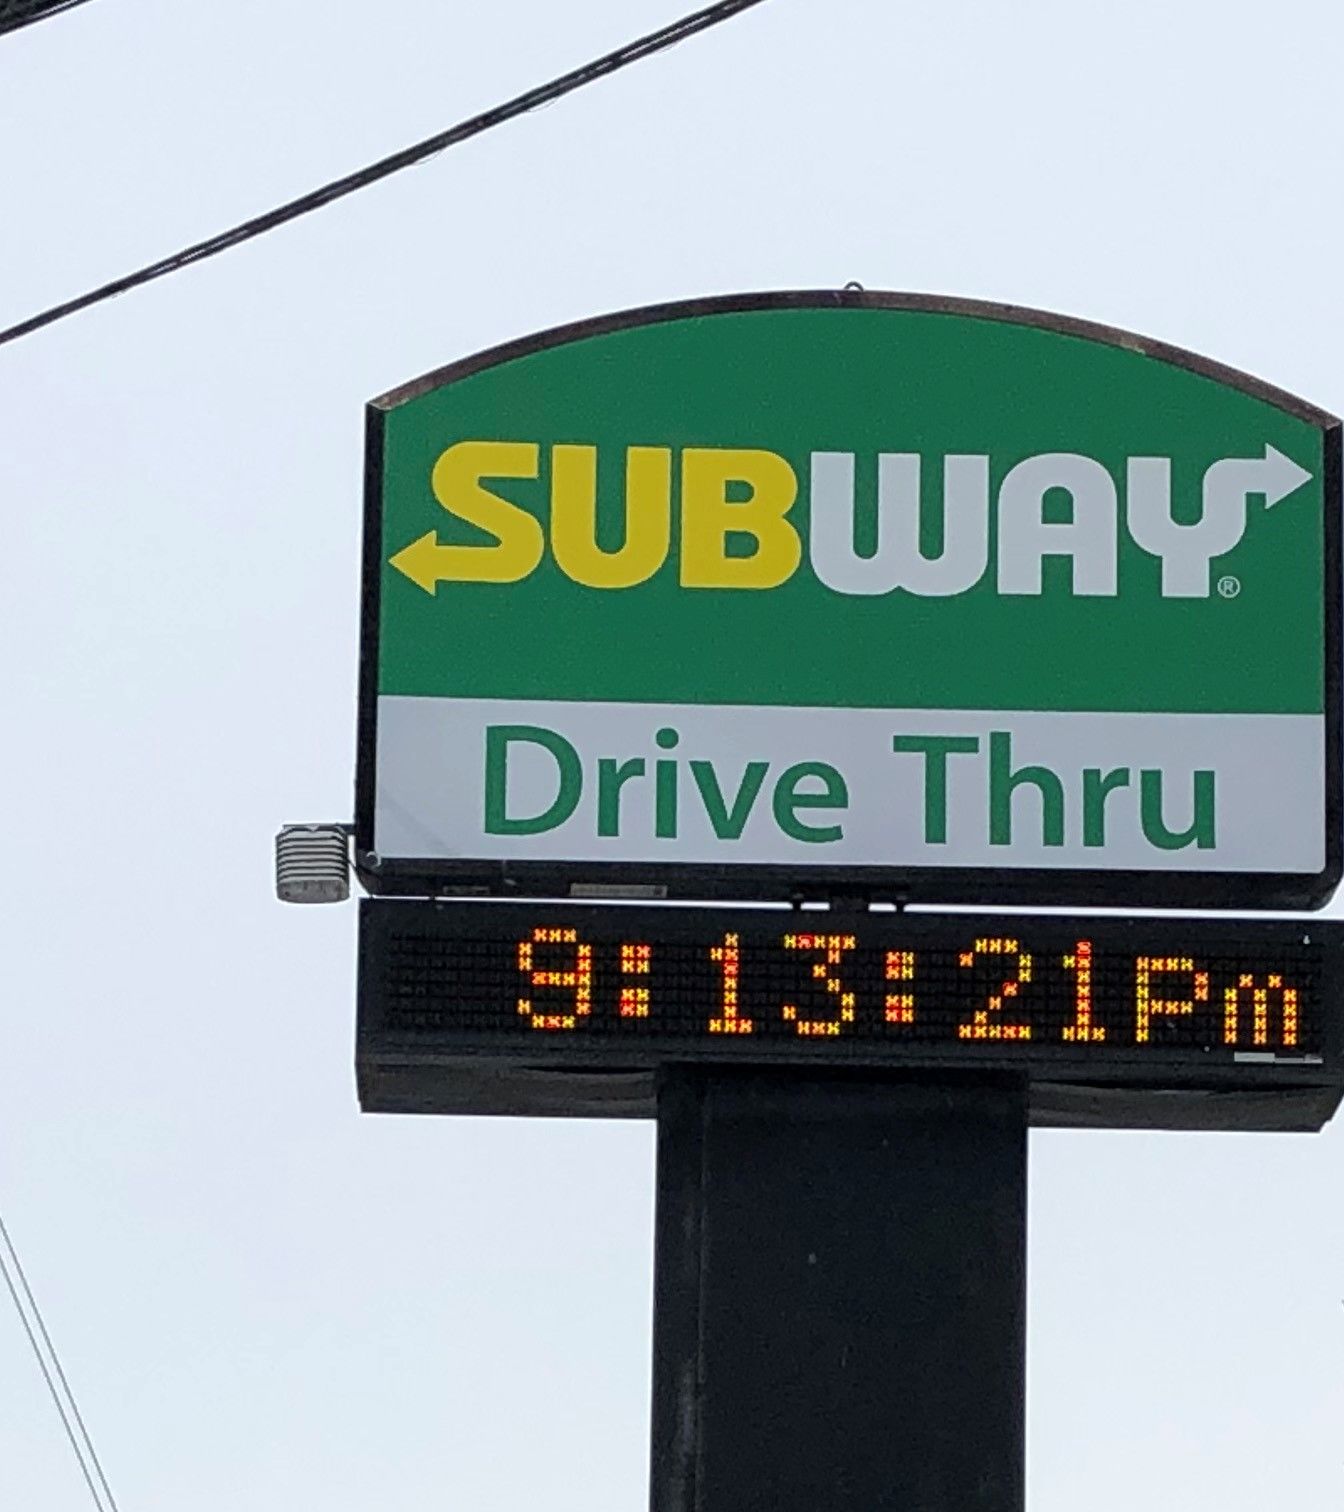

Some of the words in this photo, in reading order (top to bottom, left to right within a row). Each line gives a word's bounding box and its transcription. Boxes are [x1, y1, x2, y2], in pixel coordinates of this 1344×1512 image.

[389, 440, 1313, 597] SUBWAY
[483, 724, 850, 843] Drive
[893, 732, 1218, 850] Thru
